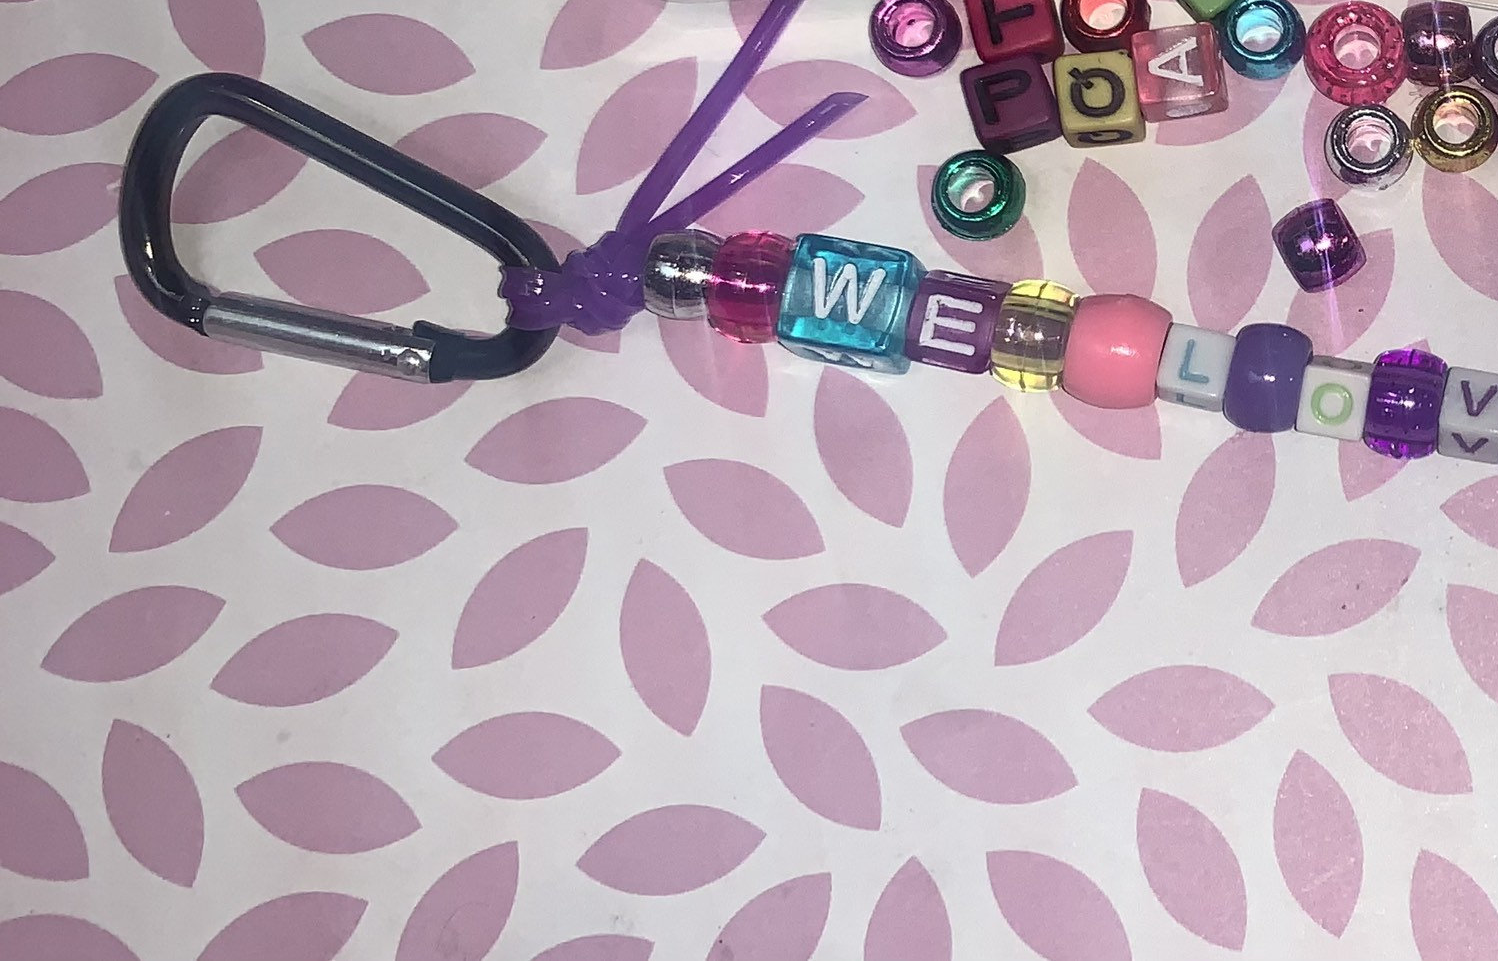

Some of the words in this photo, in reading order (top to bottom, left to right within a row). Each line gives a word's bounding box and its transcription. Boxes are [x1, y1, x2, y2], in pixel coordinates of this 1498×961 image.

[1147, 36, 1204, 86] A
[975, 69, 1032, 124] P
[1068, 67, 1126, 118] Q
[812, 257, 984, 356] WE
